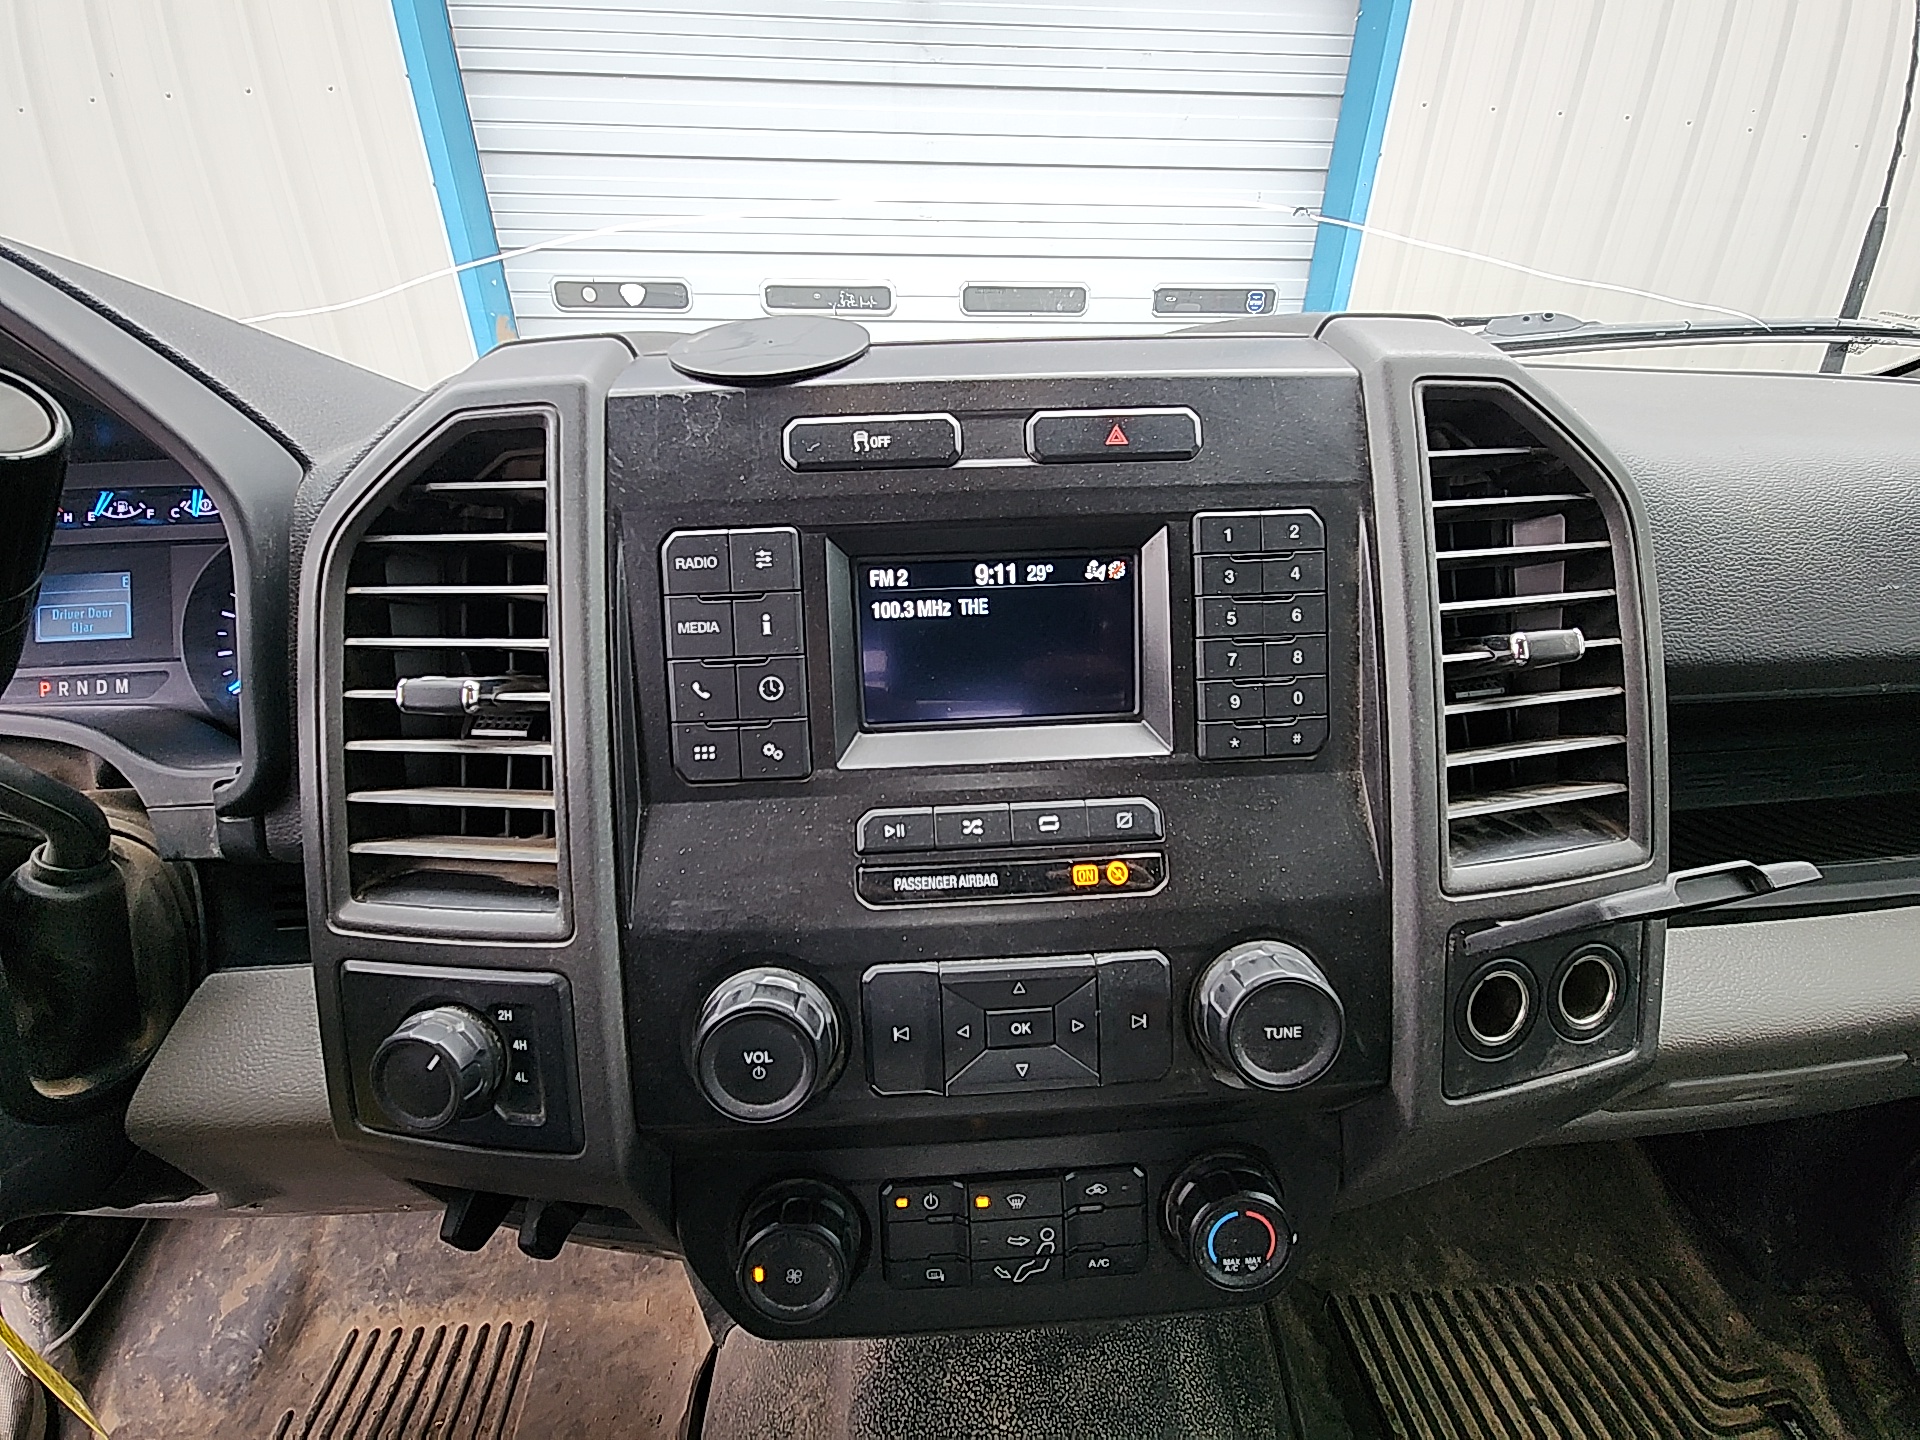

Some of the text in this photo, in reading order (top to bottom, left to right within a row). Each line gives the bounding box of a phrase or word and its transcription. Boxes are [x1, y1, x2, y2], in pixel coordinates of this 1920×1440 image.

[870, 435, 891, 449] OFF
[63, 511, 73, 523] H
[87, 511, 96, 522] E
[146, 507, 155, 519] F
[170, 507, 181, 518] C
[1223, 528, 1233, 542] 1
[1289, 524, 1300, 539] 2
[674, 556, 718, 570] RADIO
[869, 568, 909, 588] FM 2
[974, 562, 1017, 585] 9:11
[1026, 564, 1053, 582] 29°
[1224, 569, 1235, 583] 3
[1290, 566, 1301, 580] 4
[52, 607, 113, 621] Driver Door
[871, 598, 989, 619] 100.3 MHz THE
[1291, 608, 1302, 622] 6
[1226, 612, 1237, 625] 5
[71, 622, 94, 634] Ajar
[677, 621, 720, 634] MEDIA
[1227, 653, 1238, 666] 7
[1292, 650, 1303, 664] 8
[39, 679, 129, 697] P R N D M
[1229, 695, 1241, 709] 9
[1293, 690, 1304, 705] 0
[893, 873, 999, 891] PASSENGER AIRBAG
[1077, 869, 1095, 882] ON
[497, 1010, 513, 1021] 2H
[1010, 1021, 1032, 1035] OK
[1263, 1026, 1303, 1040] TUNE
[512, 1040, 527, 1051] 4H
[743, 1050, 774, 1065] VOL
[514, 1072, 528, 1083] 4L
[1088, 1258, 1110, 1268] A/C
[1244, 1256, 1262, 1264] MAX
